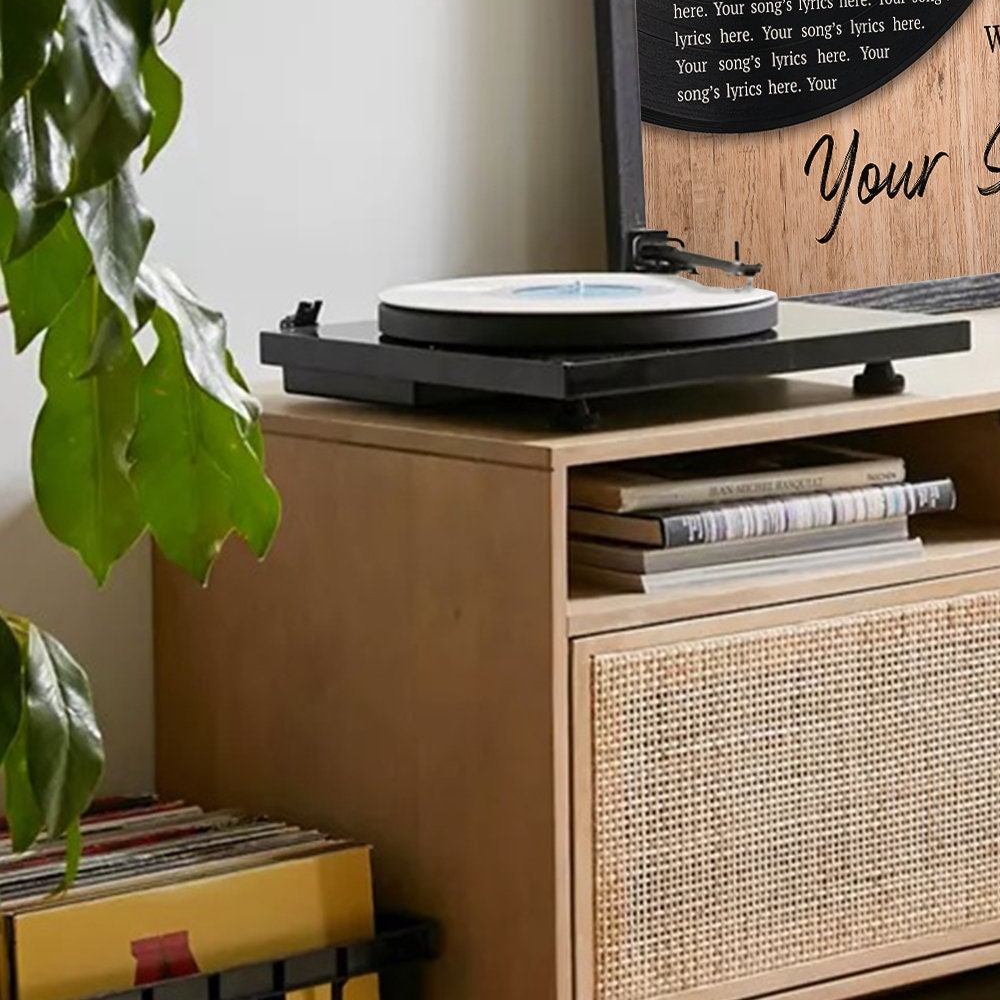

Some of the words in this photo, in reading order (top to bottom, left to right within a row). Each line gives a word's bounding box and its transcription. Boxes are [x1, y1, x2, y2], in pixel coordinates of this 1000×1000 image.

[673, 4, 707, 19] here.
[713, 1, 744, 16] Your
[675, 30, 711, 50] lyrics
[720, 28, 754, 43] here.
[762, 26, 793, 40] Your
[802, 22, 842, 39] song's
[850, 18, 885, 37] lyrics
[893, 16, 925, 31] here.
[677, 85, 720, 104] song's
[726, 81, 762, 101] lyrics
[768, 79, 801, 95] here.
[806, 77, 837, 91] Your
[803, 128, 949, 245] Your
